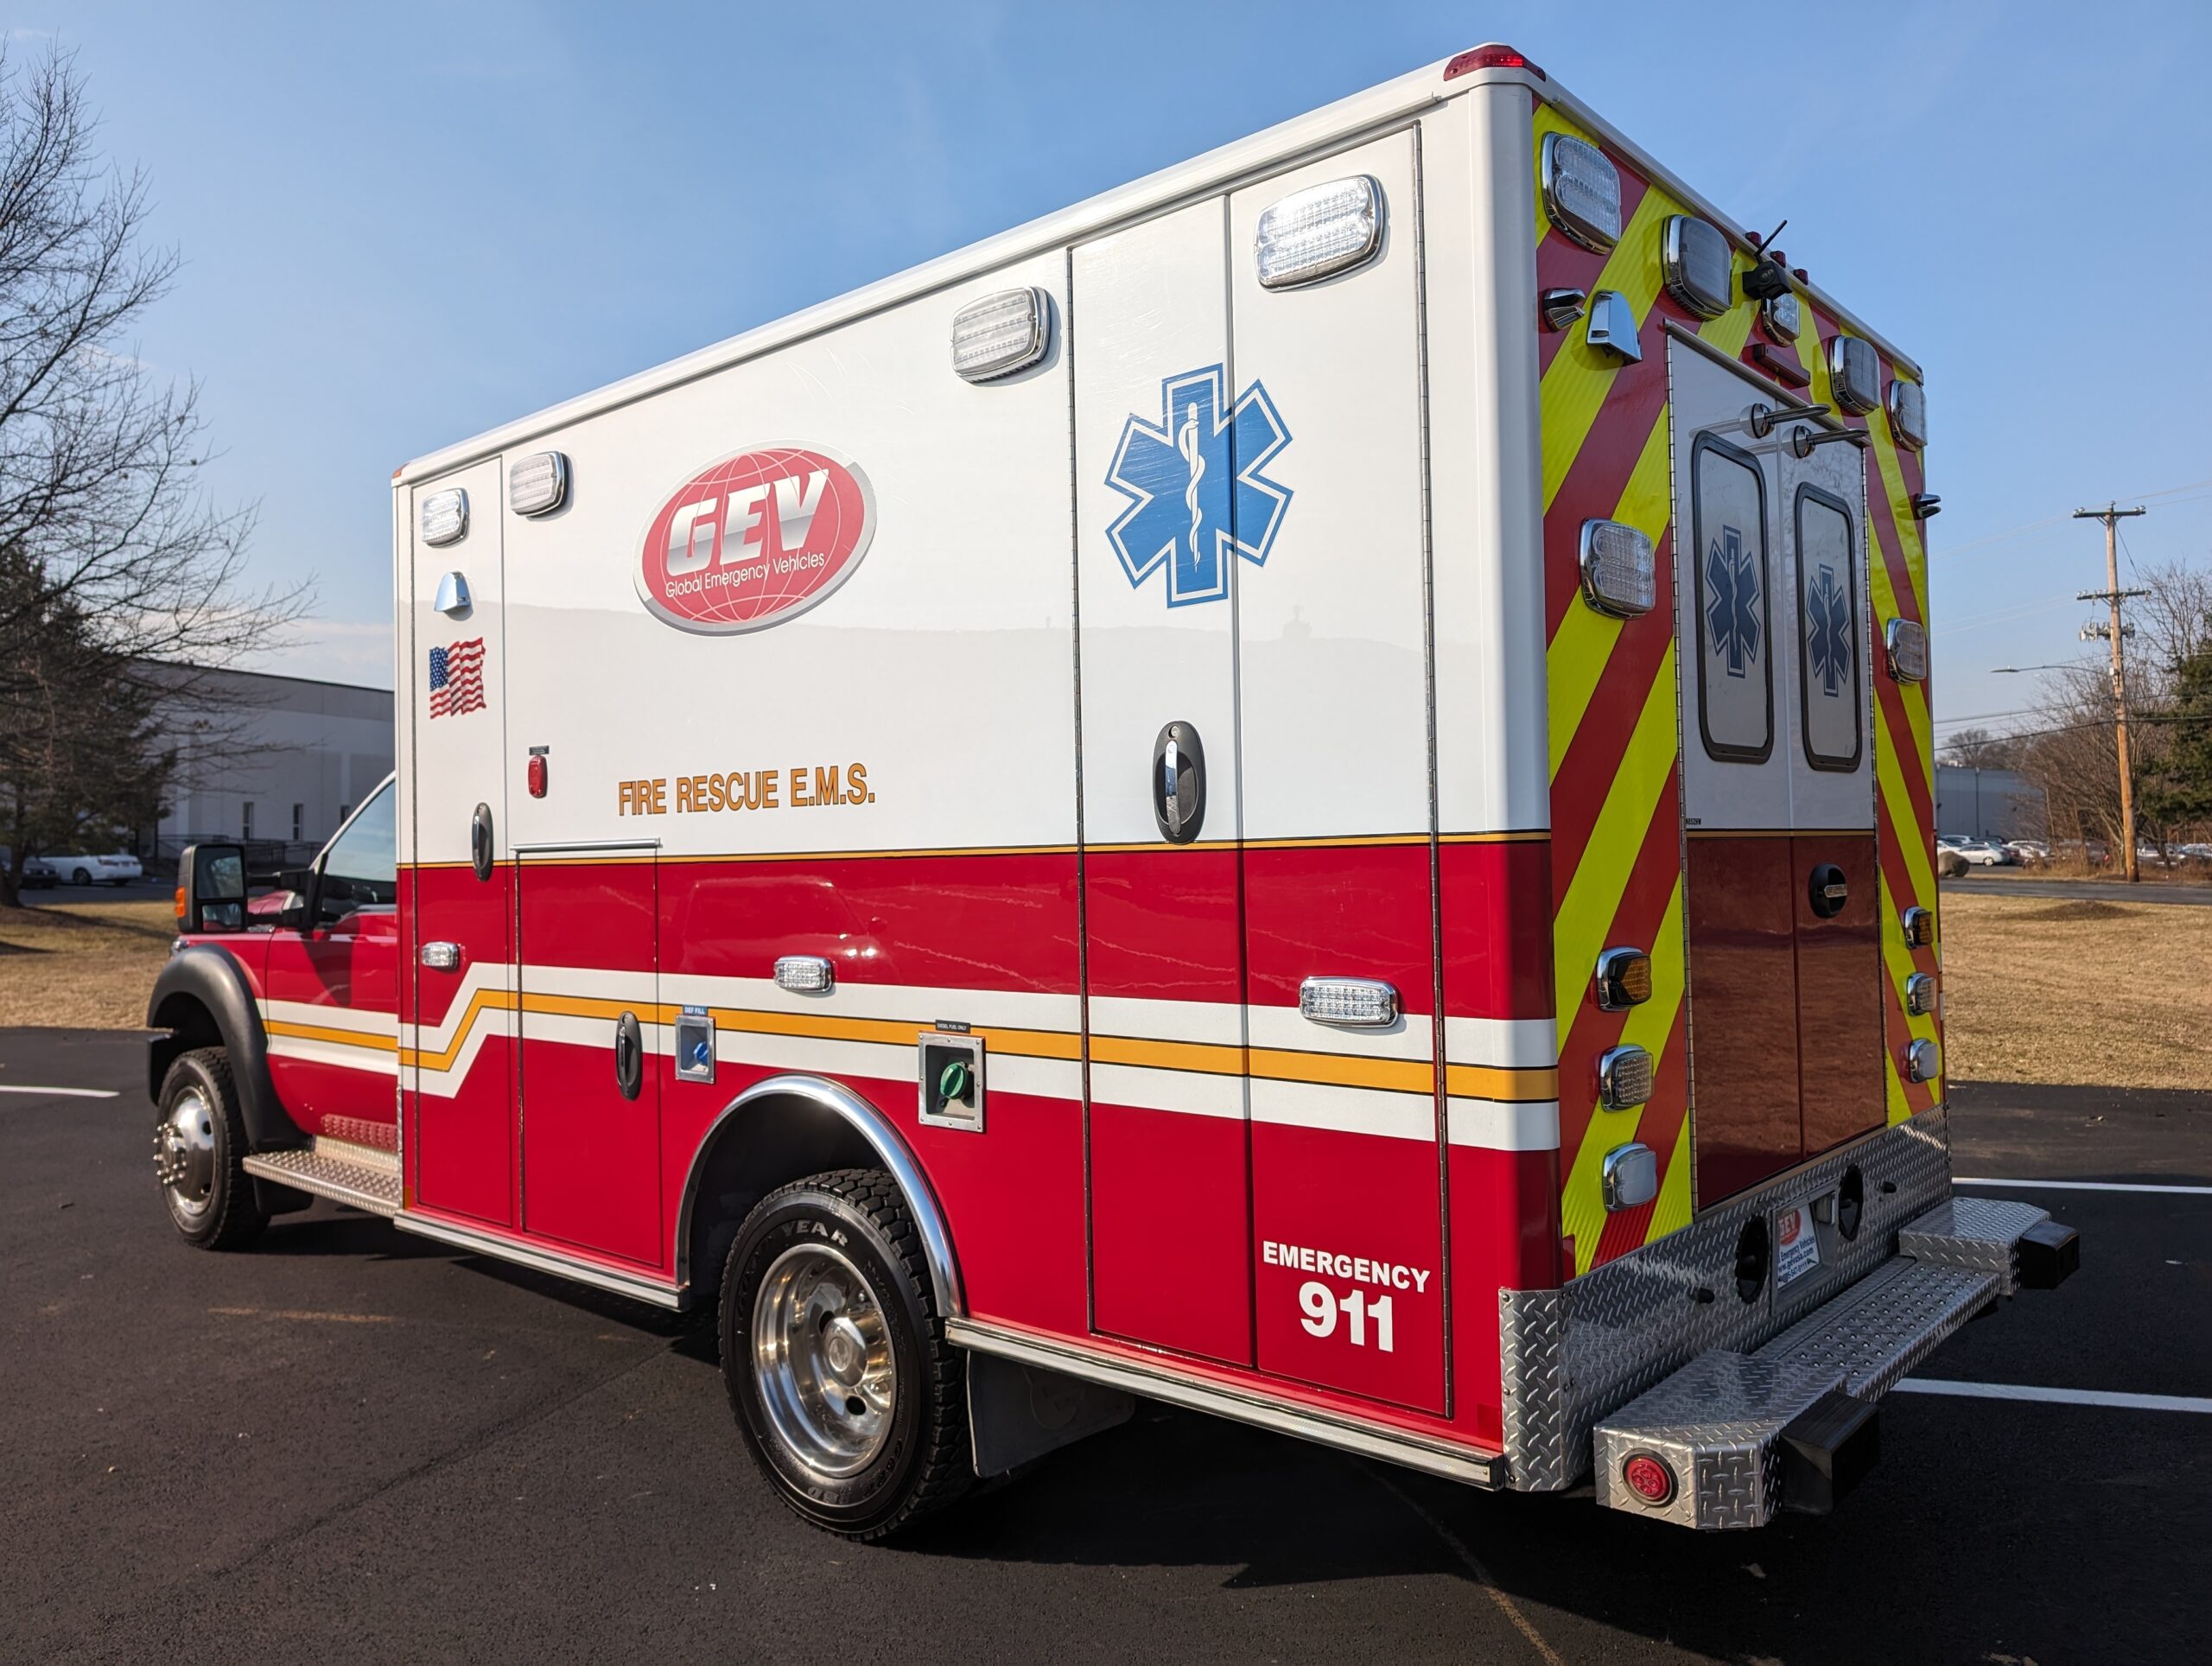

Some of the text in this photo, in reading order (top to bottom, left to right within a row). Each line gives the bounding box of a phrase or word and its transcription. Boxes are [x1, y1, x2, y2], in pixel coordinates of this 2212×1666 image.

[666, 468, 830, 576] GEV
[665, 550, 825, 598] Global Emergency Vehicles
[619, 763, 875, 816] FIRE RESCUE E.M.S.
[684, 1006, 706, 1015] DEF FILL
[1262, 1240, 1430, 1293] EMERGENCY
[1299, 1281, 1394, 1352] 911
